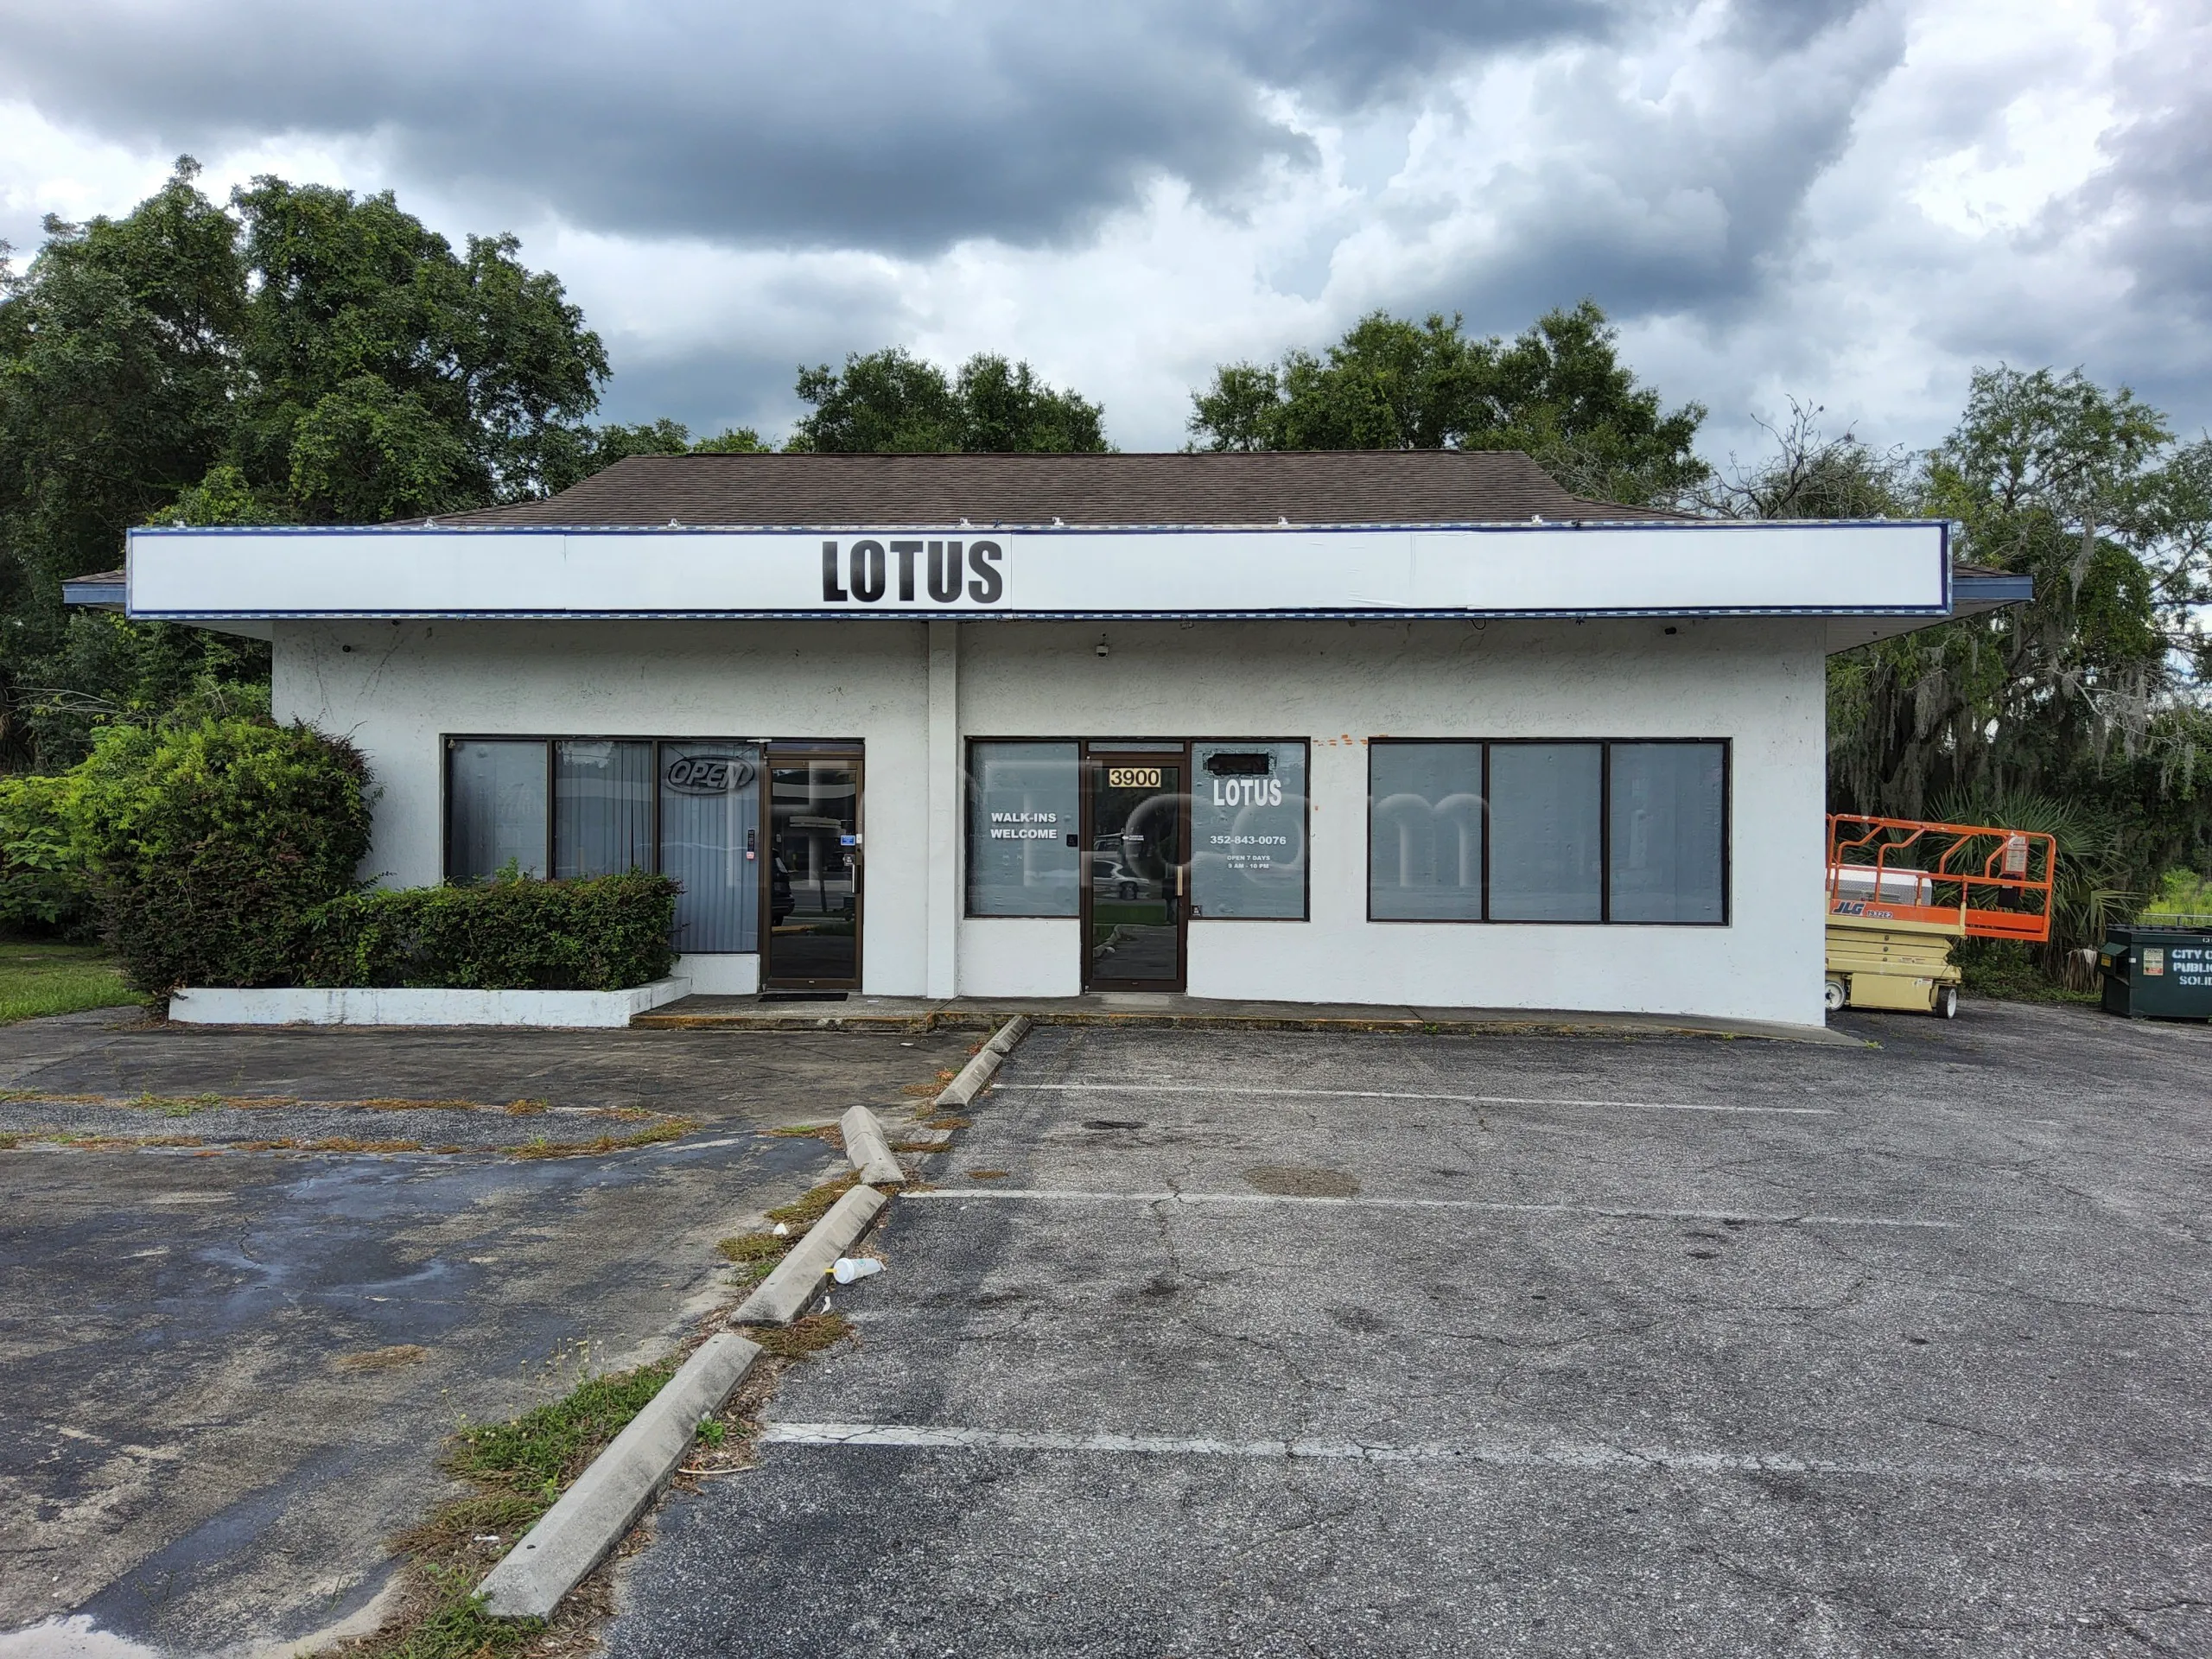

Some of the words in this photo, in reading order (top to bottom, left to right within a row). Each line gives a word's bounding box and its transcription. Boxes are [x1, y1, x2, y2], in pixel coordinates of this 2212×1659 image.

[822, 539, 1003, 603] LOTUS
[670, 760, 744, 790] OPEN
[1110, 769, 1160, 786] 3900
[1213, 779, 1282, 807] LOTUS
[990, 812, 1057, 823] WALK-INS
[989, 829, 1058, 839] WELCOME
[1210, 835, 1287, 845] 352-843-0076
[1833, 901, 1866, 915] JLG
[2171, 949, 2202, 959] CITY
[2173, 962, 2212, 973] PUBLI
